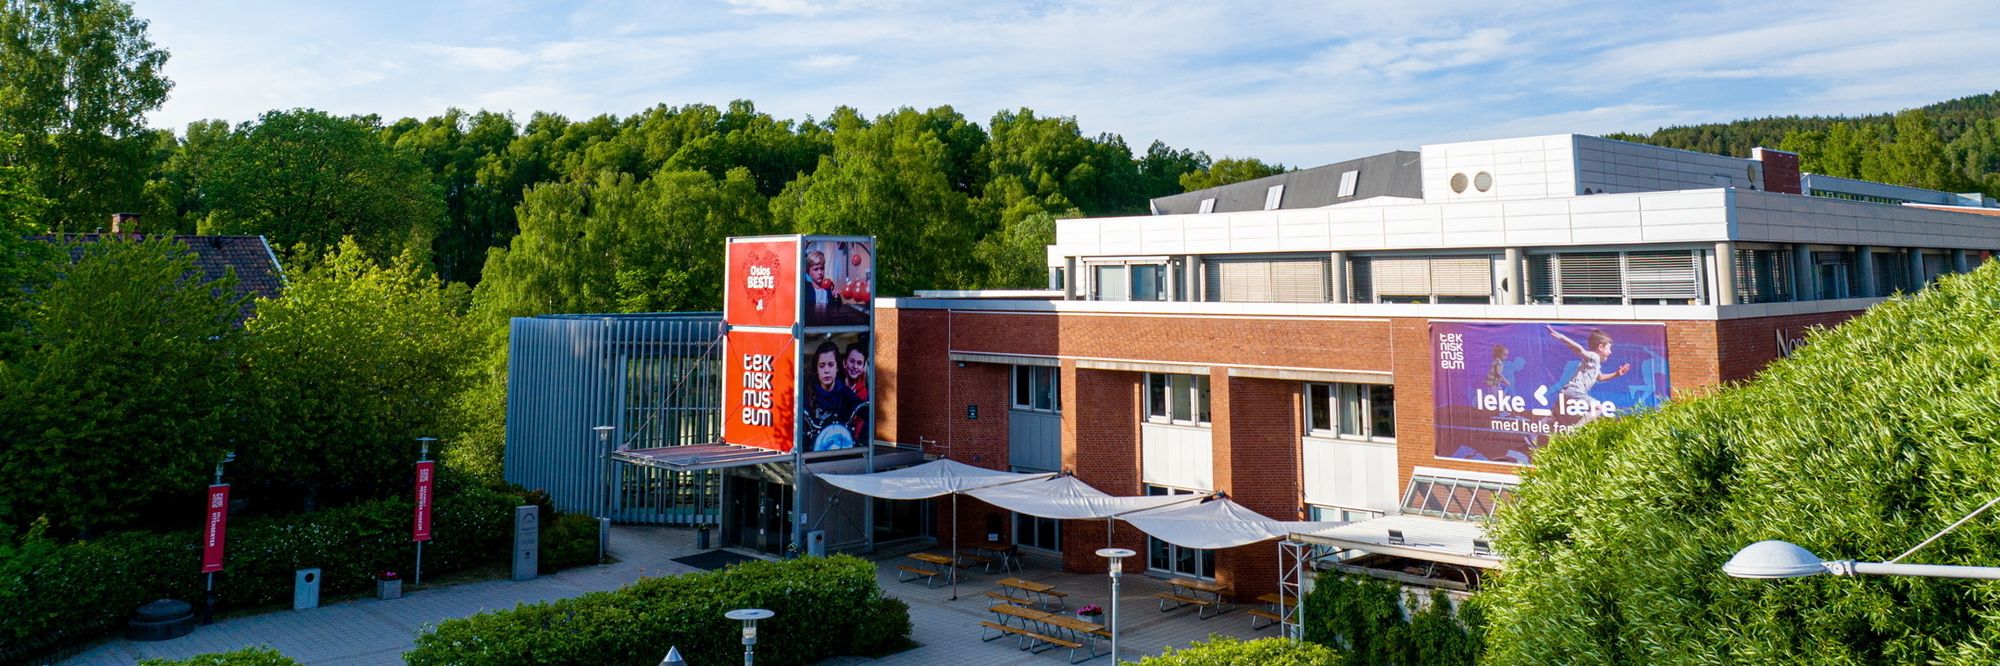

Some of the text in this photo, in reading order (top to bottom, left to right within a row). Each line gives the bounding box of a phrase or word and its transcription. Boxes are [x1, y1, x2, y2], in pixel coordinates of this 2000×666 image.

[750, 265, 771, 276] Oslos
[747, 276, 774, 289] BESTE
[1440, 333, 1463, 343] tek
[743, 353, 773, 372] tek
[1440, 351, 1464, 361] mus
[1441, 360, 1465, 370] eum
[742, 389, 773, 409] mus
[1476, 388, 1617, 418] leke lære
[742, 407, 773, 427] eum
[1491, 418, 1519, 432] med
[1522, 419, 1550, 434] hele
